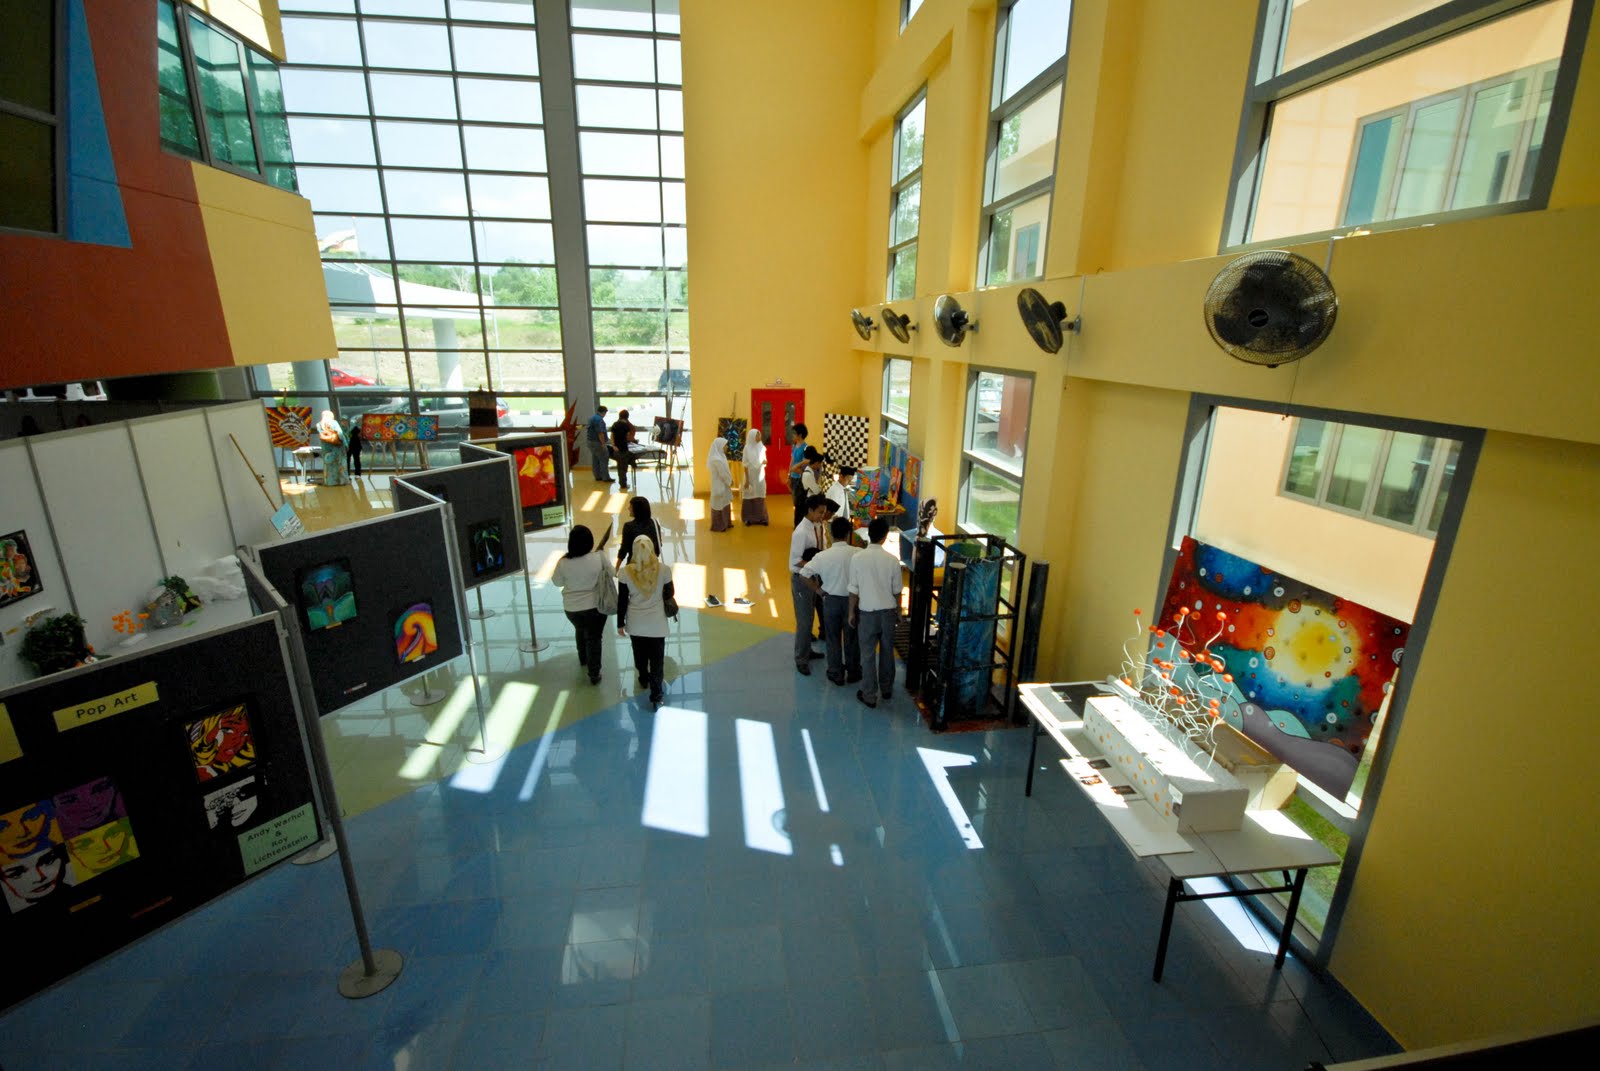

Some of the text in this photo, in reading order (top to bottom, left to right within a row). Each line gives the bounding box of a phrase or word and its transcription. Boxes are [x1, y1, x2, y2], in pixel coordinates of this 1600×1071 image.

[76, 693, 138, 718] Pop Art
[247, 810, 305, 841] Andy Warhol
[254, 834, 309, 865] Lichtenstein
[271, 836, 288, 847] Roy
